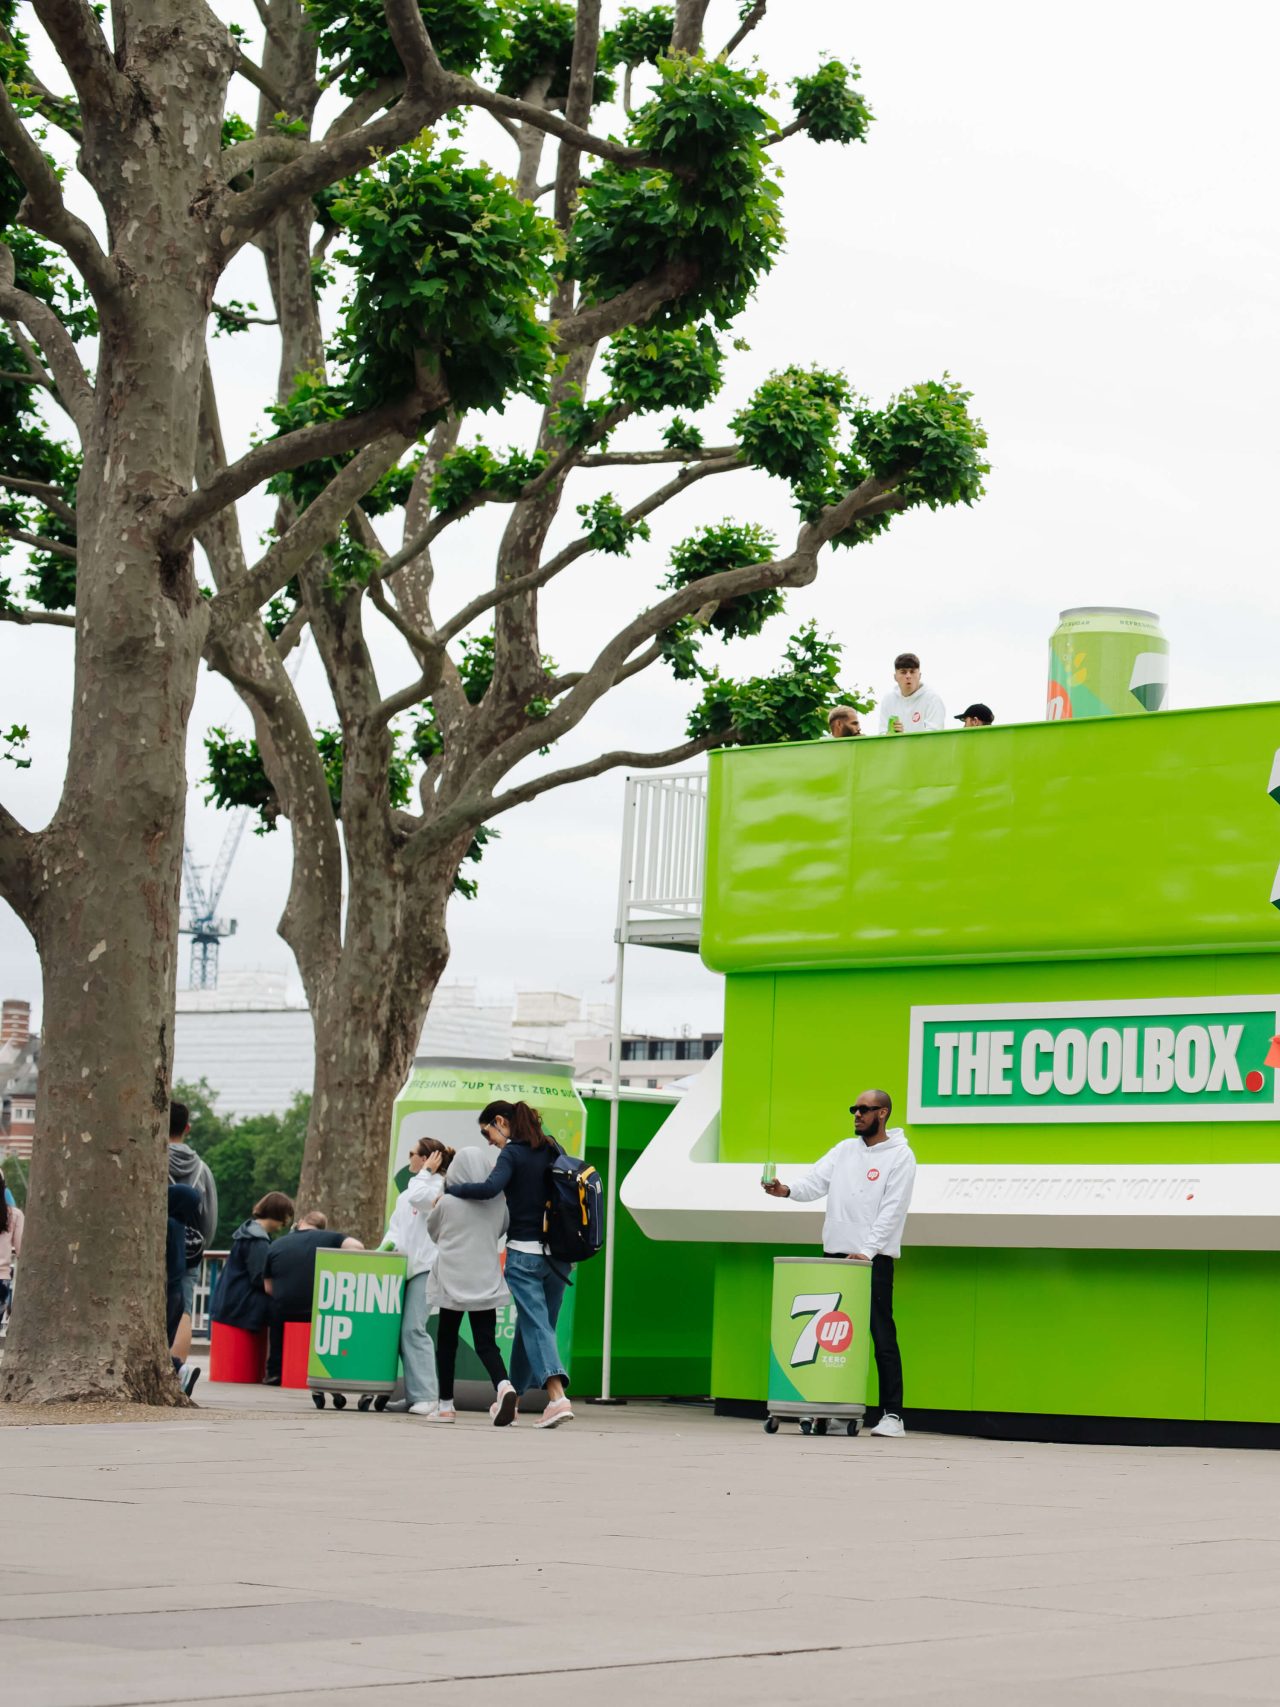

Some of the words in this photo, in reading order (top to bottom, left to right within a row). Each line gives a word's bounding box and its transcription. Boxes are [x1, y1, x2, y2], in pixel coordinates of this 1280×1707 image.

[934, 1031, 1015, 1096] THE
[1020, 1024, 1265, 1096] COOLBOX.
[461, 1081, 484, 1090] 7UP
[488, 1083, 529, 1094] TASTE.
[532, 1086, 559, 1096] ZERO
[318, 1270, 403, 1314] DRINK
[314, 1314, 353, 1356] UP.
[821, 1355, 847, 1363] ZERO
